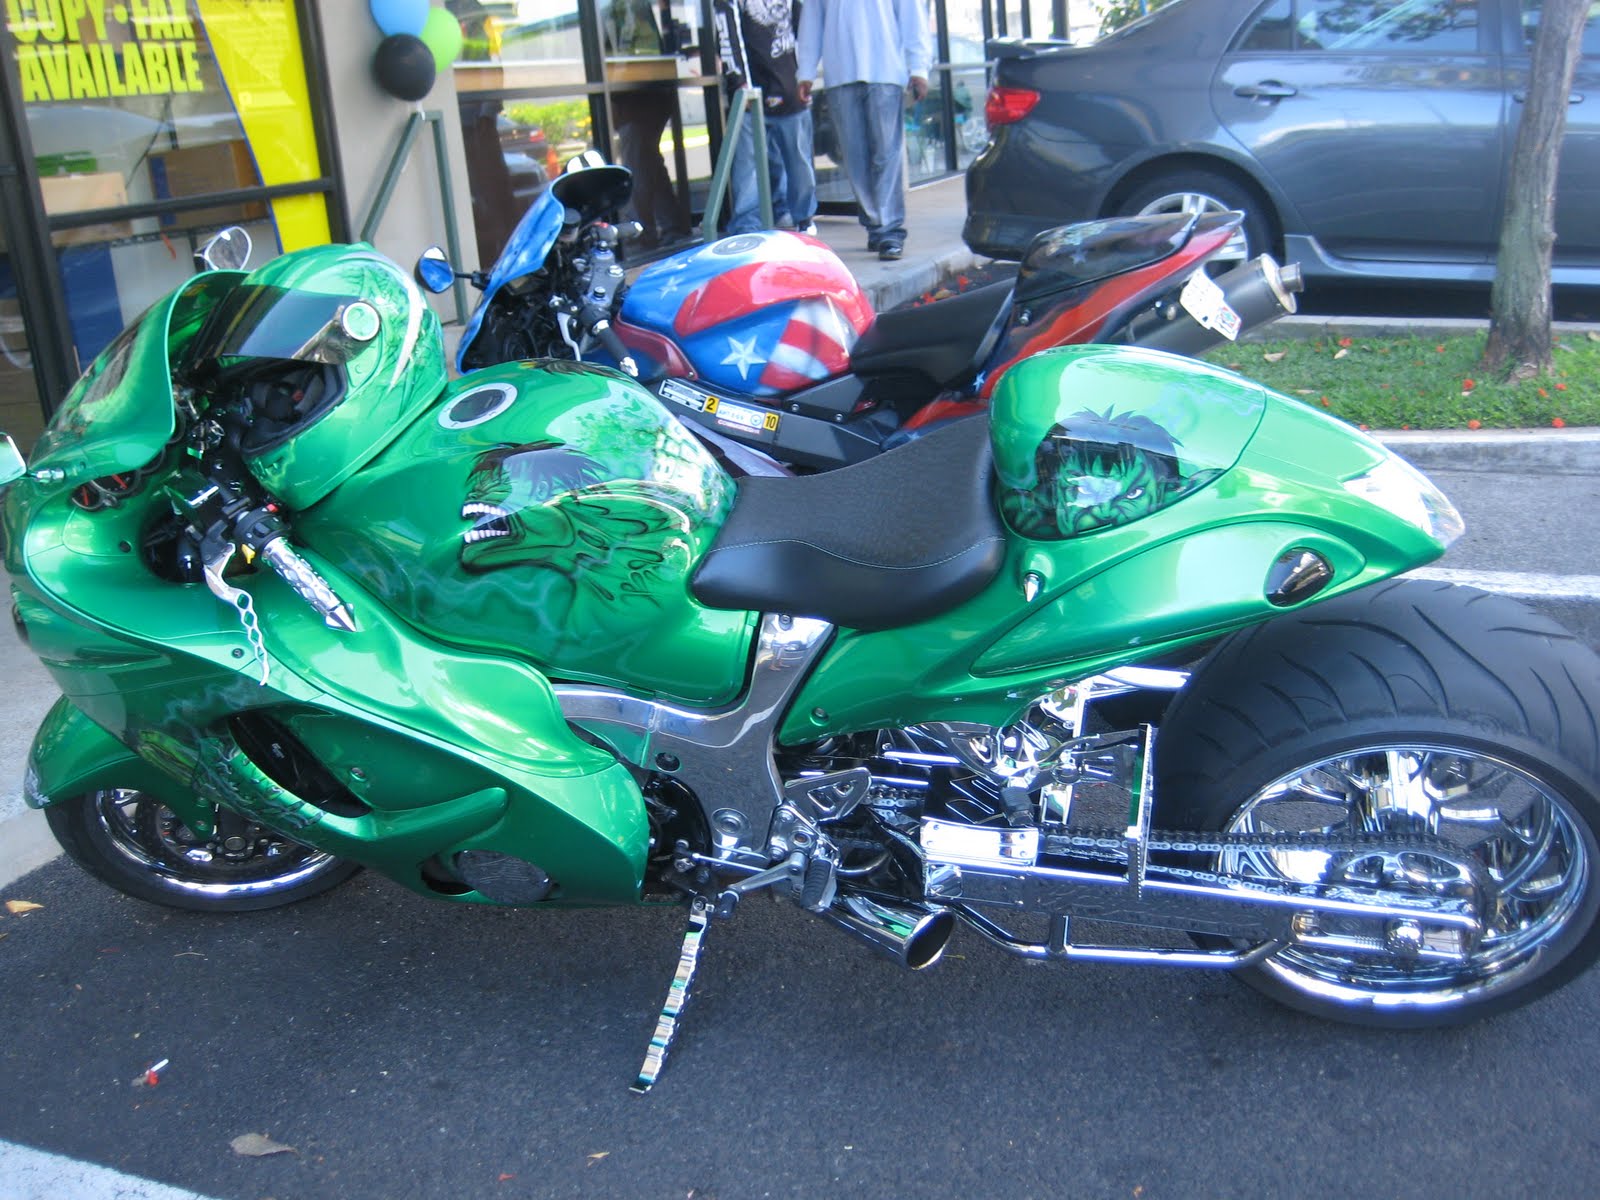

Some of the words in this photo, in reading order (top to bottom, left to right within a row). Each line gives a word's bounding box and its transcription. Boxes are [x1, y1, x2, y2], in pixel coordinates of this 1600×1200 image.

[15, 41, 204, 102] AVAILABLE
[706, 397, 716, 411] 2
[766, 415, 777, 429] 10
